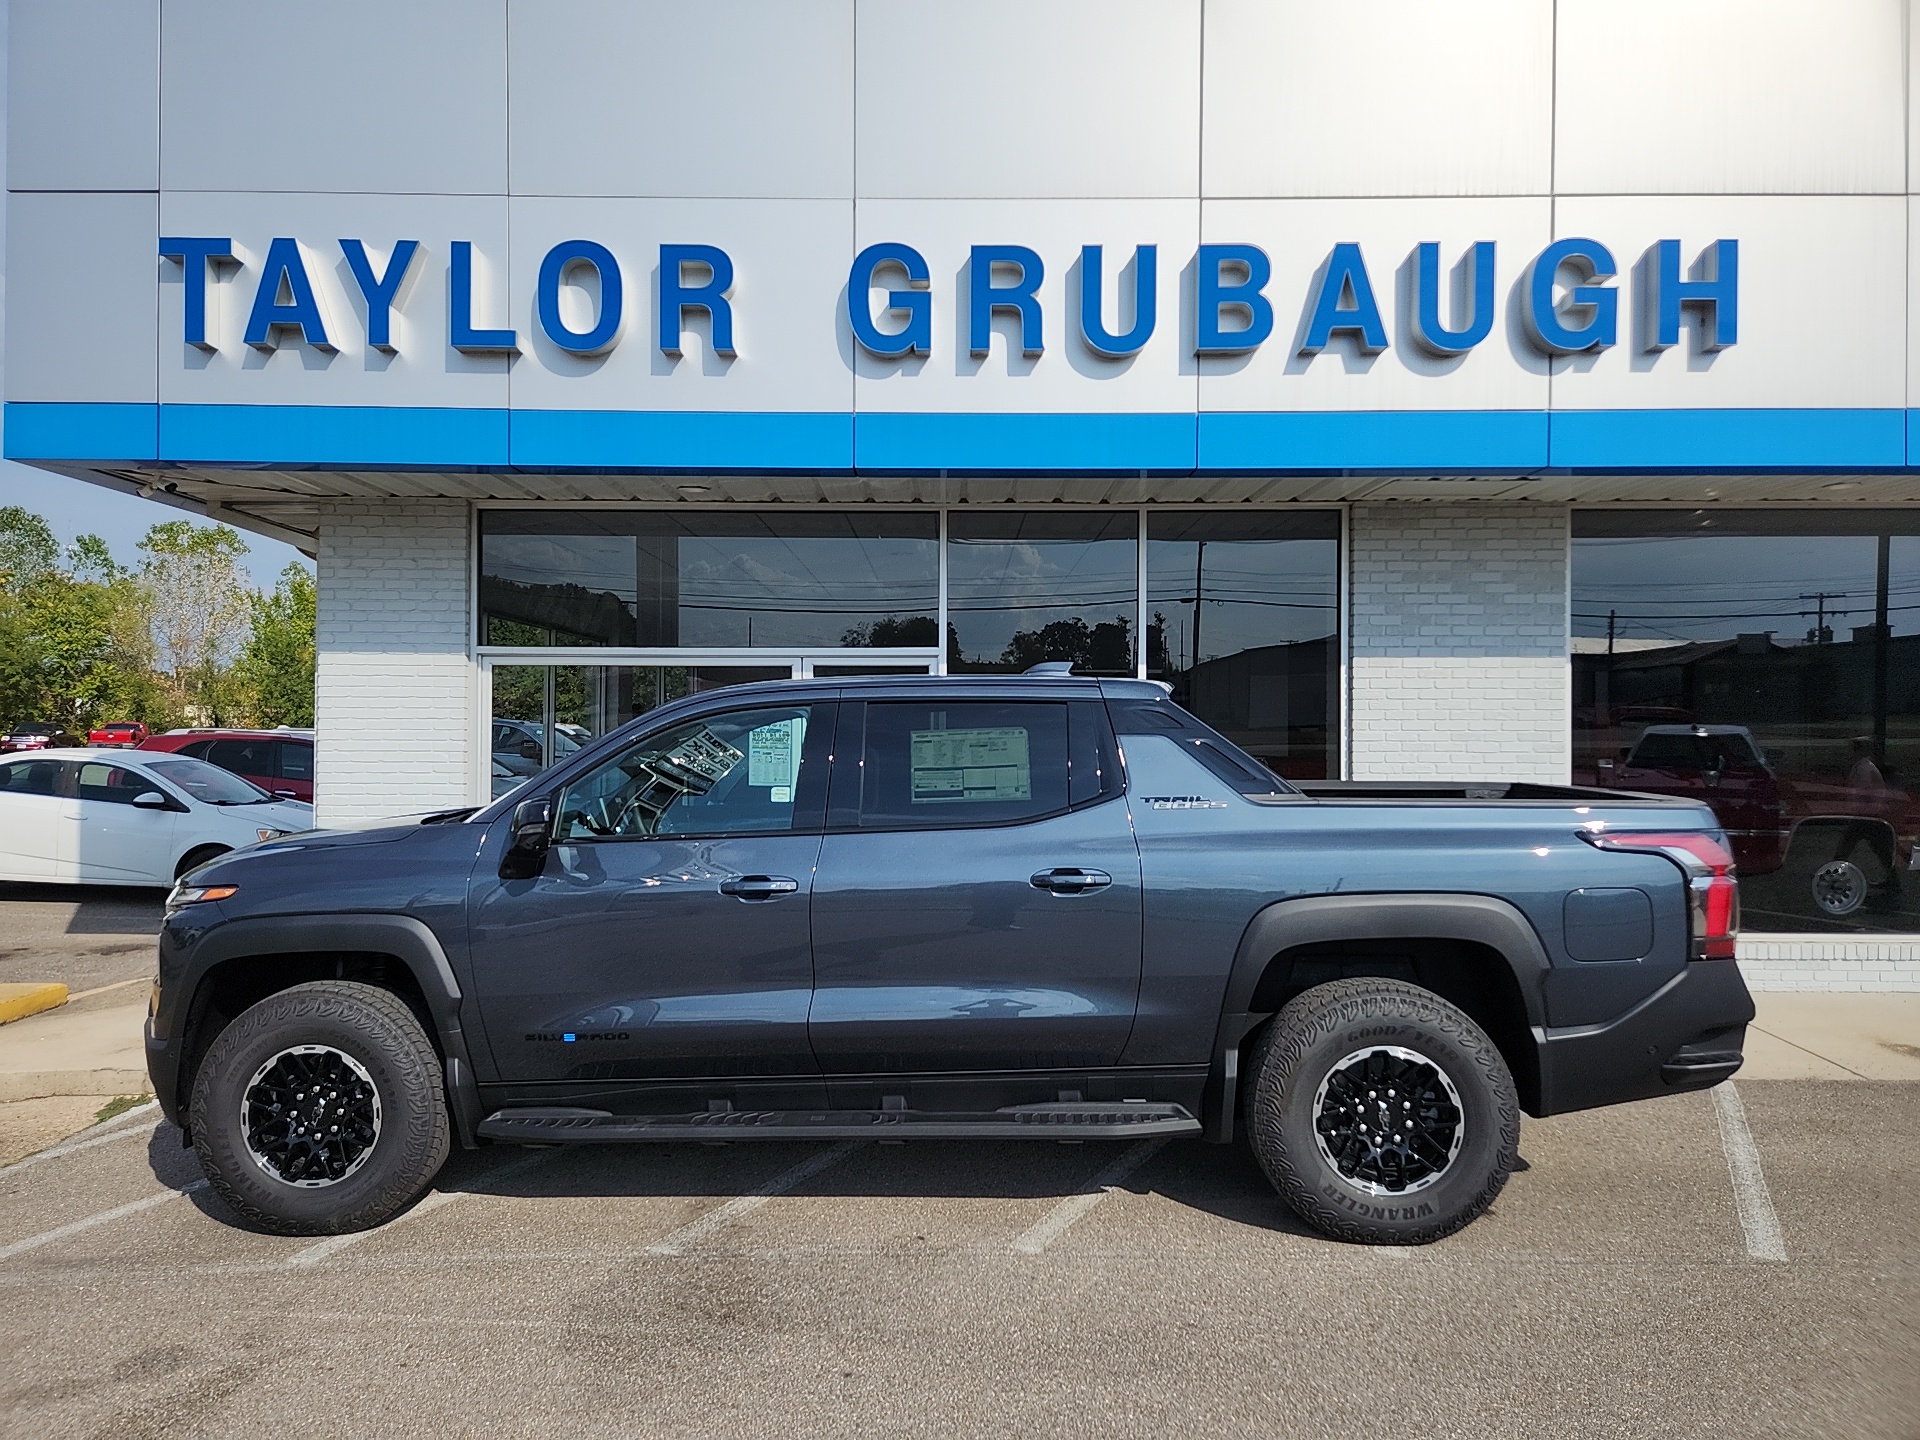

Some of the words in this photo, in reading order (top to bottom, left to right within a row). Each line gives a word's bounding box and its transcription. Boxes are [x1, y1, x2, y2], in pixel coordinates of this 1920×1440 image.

[159, 237, 737, 355] TAYLOR
[848, 237, 1738, 355] GRUBAUGH
[1152, 800, 1228, 811] BOSS
[524, 1032, 630, 1043] SILVERADO
[1323, 1183, 1435, 1221] WRANGLER
